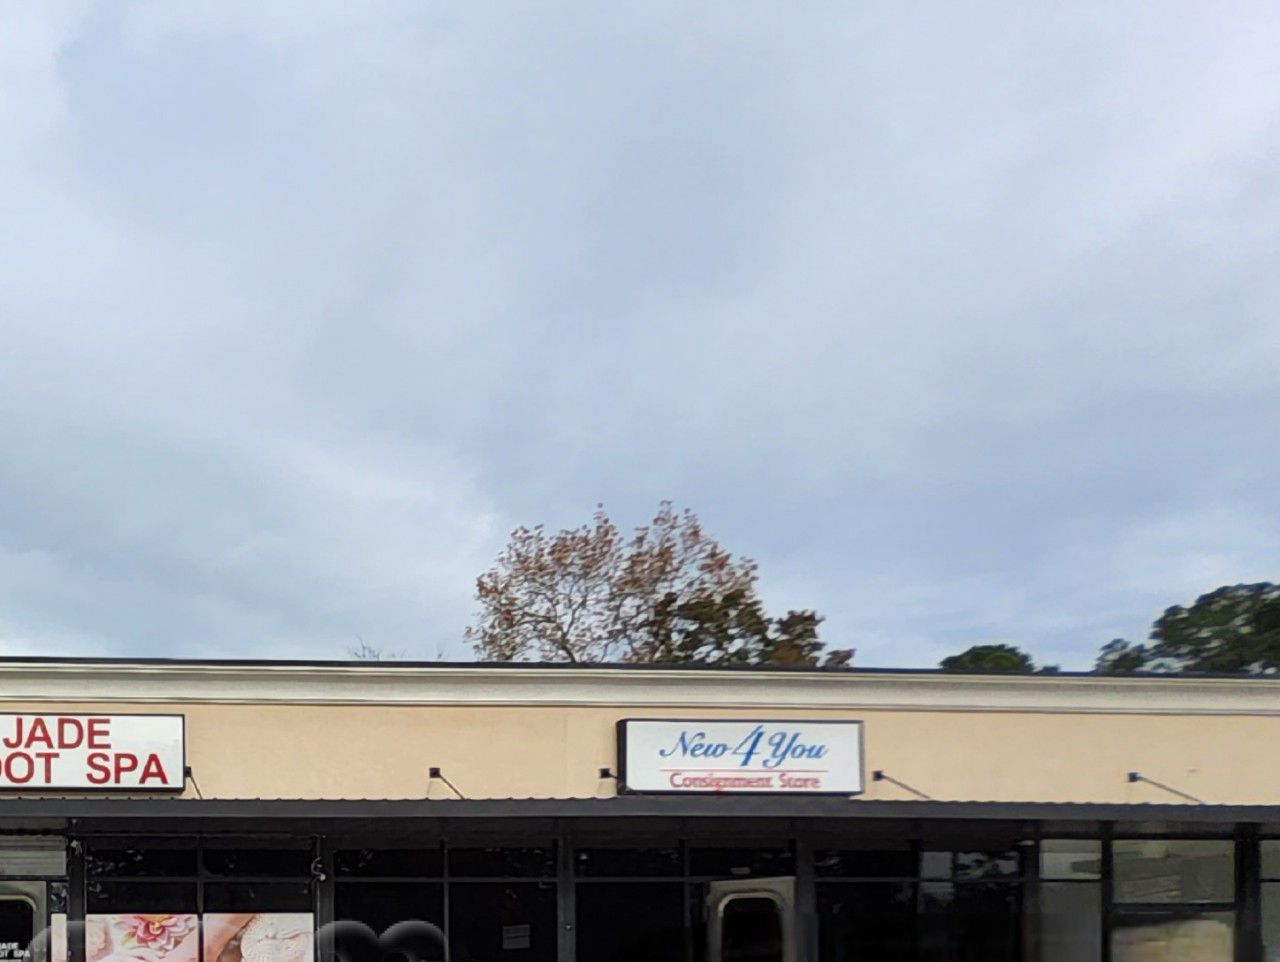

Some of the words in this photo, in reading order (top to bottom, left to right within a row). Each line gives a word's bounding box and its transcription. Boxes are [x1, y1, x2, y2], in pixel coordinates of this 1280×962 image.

[2, 717, 112, 749] JADE
[659, 730, 731, 758] New
[731, 725, 765, 767] 4
[762, 730, 828, 769] You
[86, 752, 169, 785] SPA
[669, 771, 772, 792] Consignment
[13, 950, 31, 958] SPA
